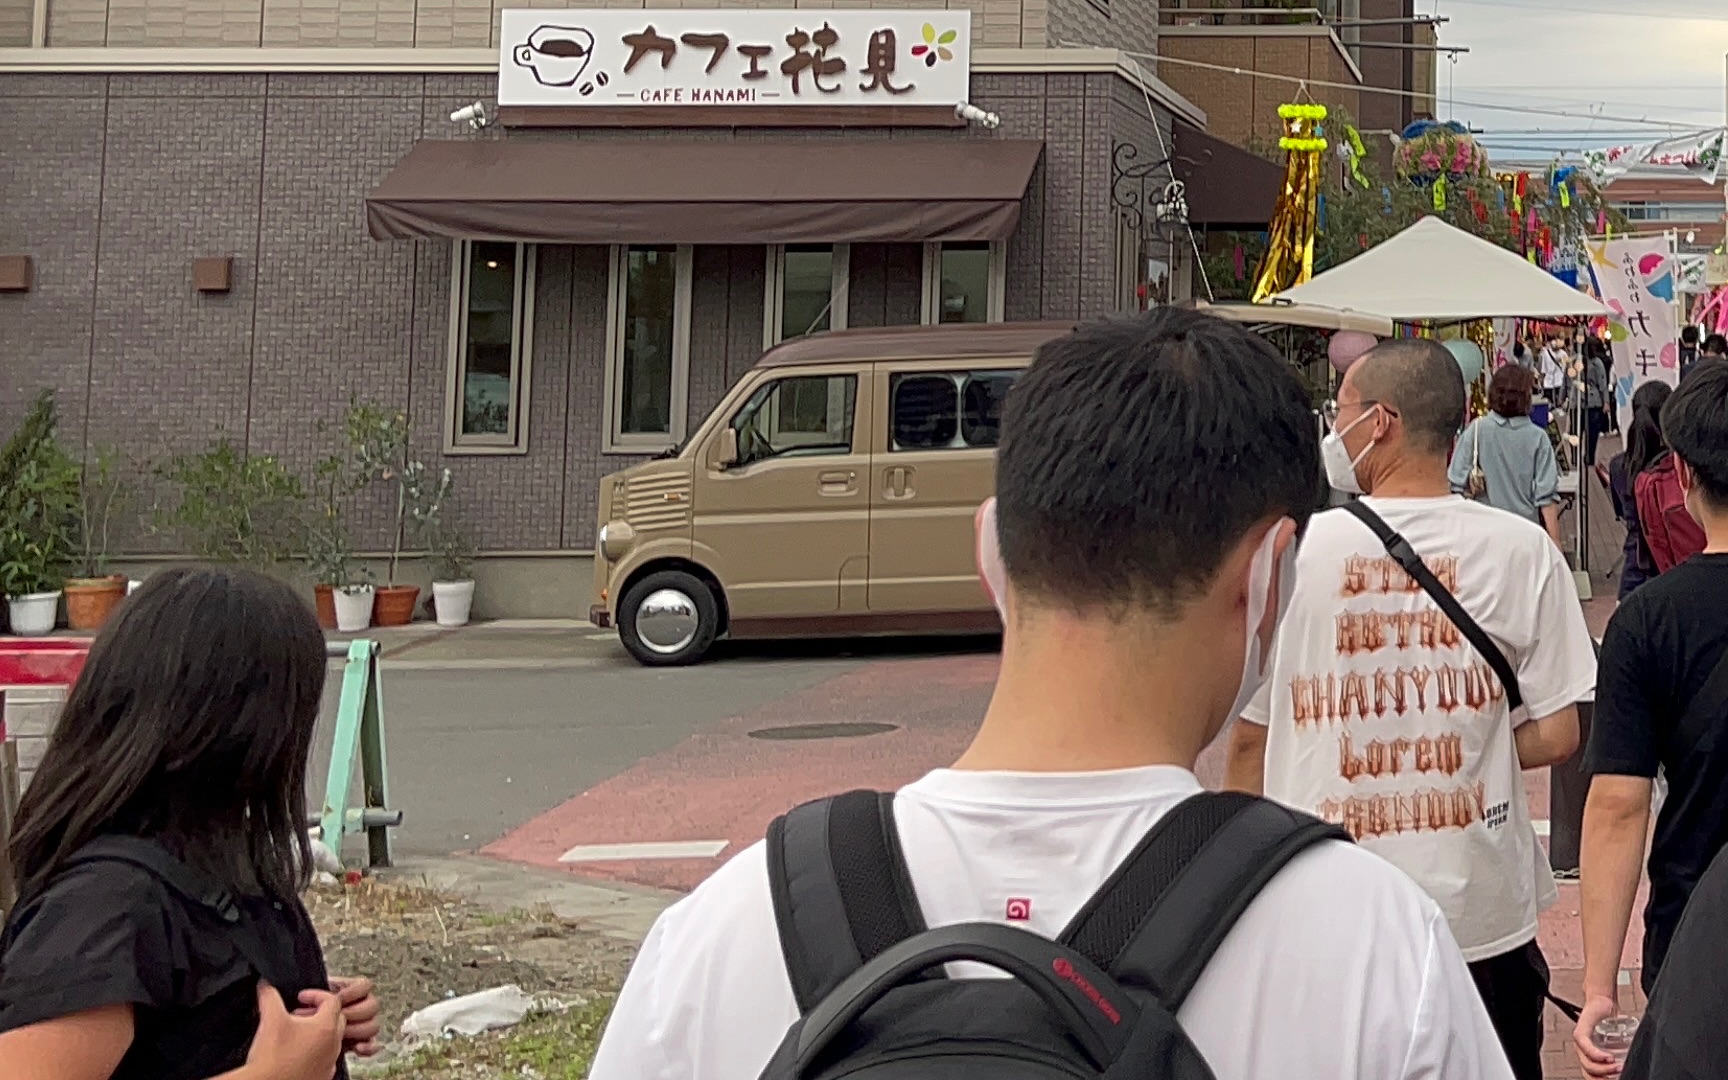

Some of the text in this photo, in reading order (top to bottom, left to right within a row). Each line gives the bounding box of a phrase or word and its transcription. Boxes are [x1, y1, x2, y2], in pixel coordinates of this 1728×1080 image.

[621, 21, 915, 96] カフェ花見
[640, 87, 756, 103] CAFE HANAMI
